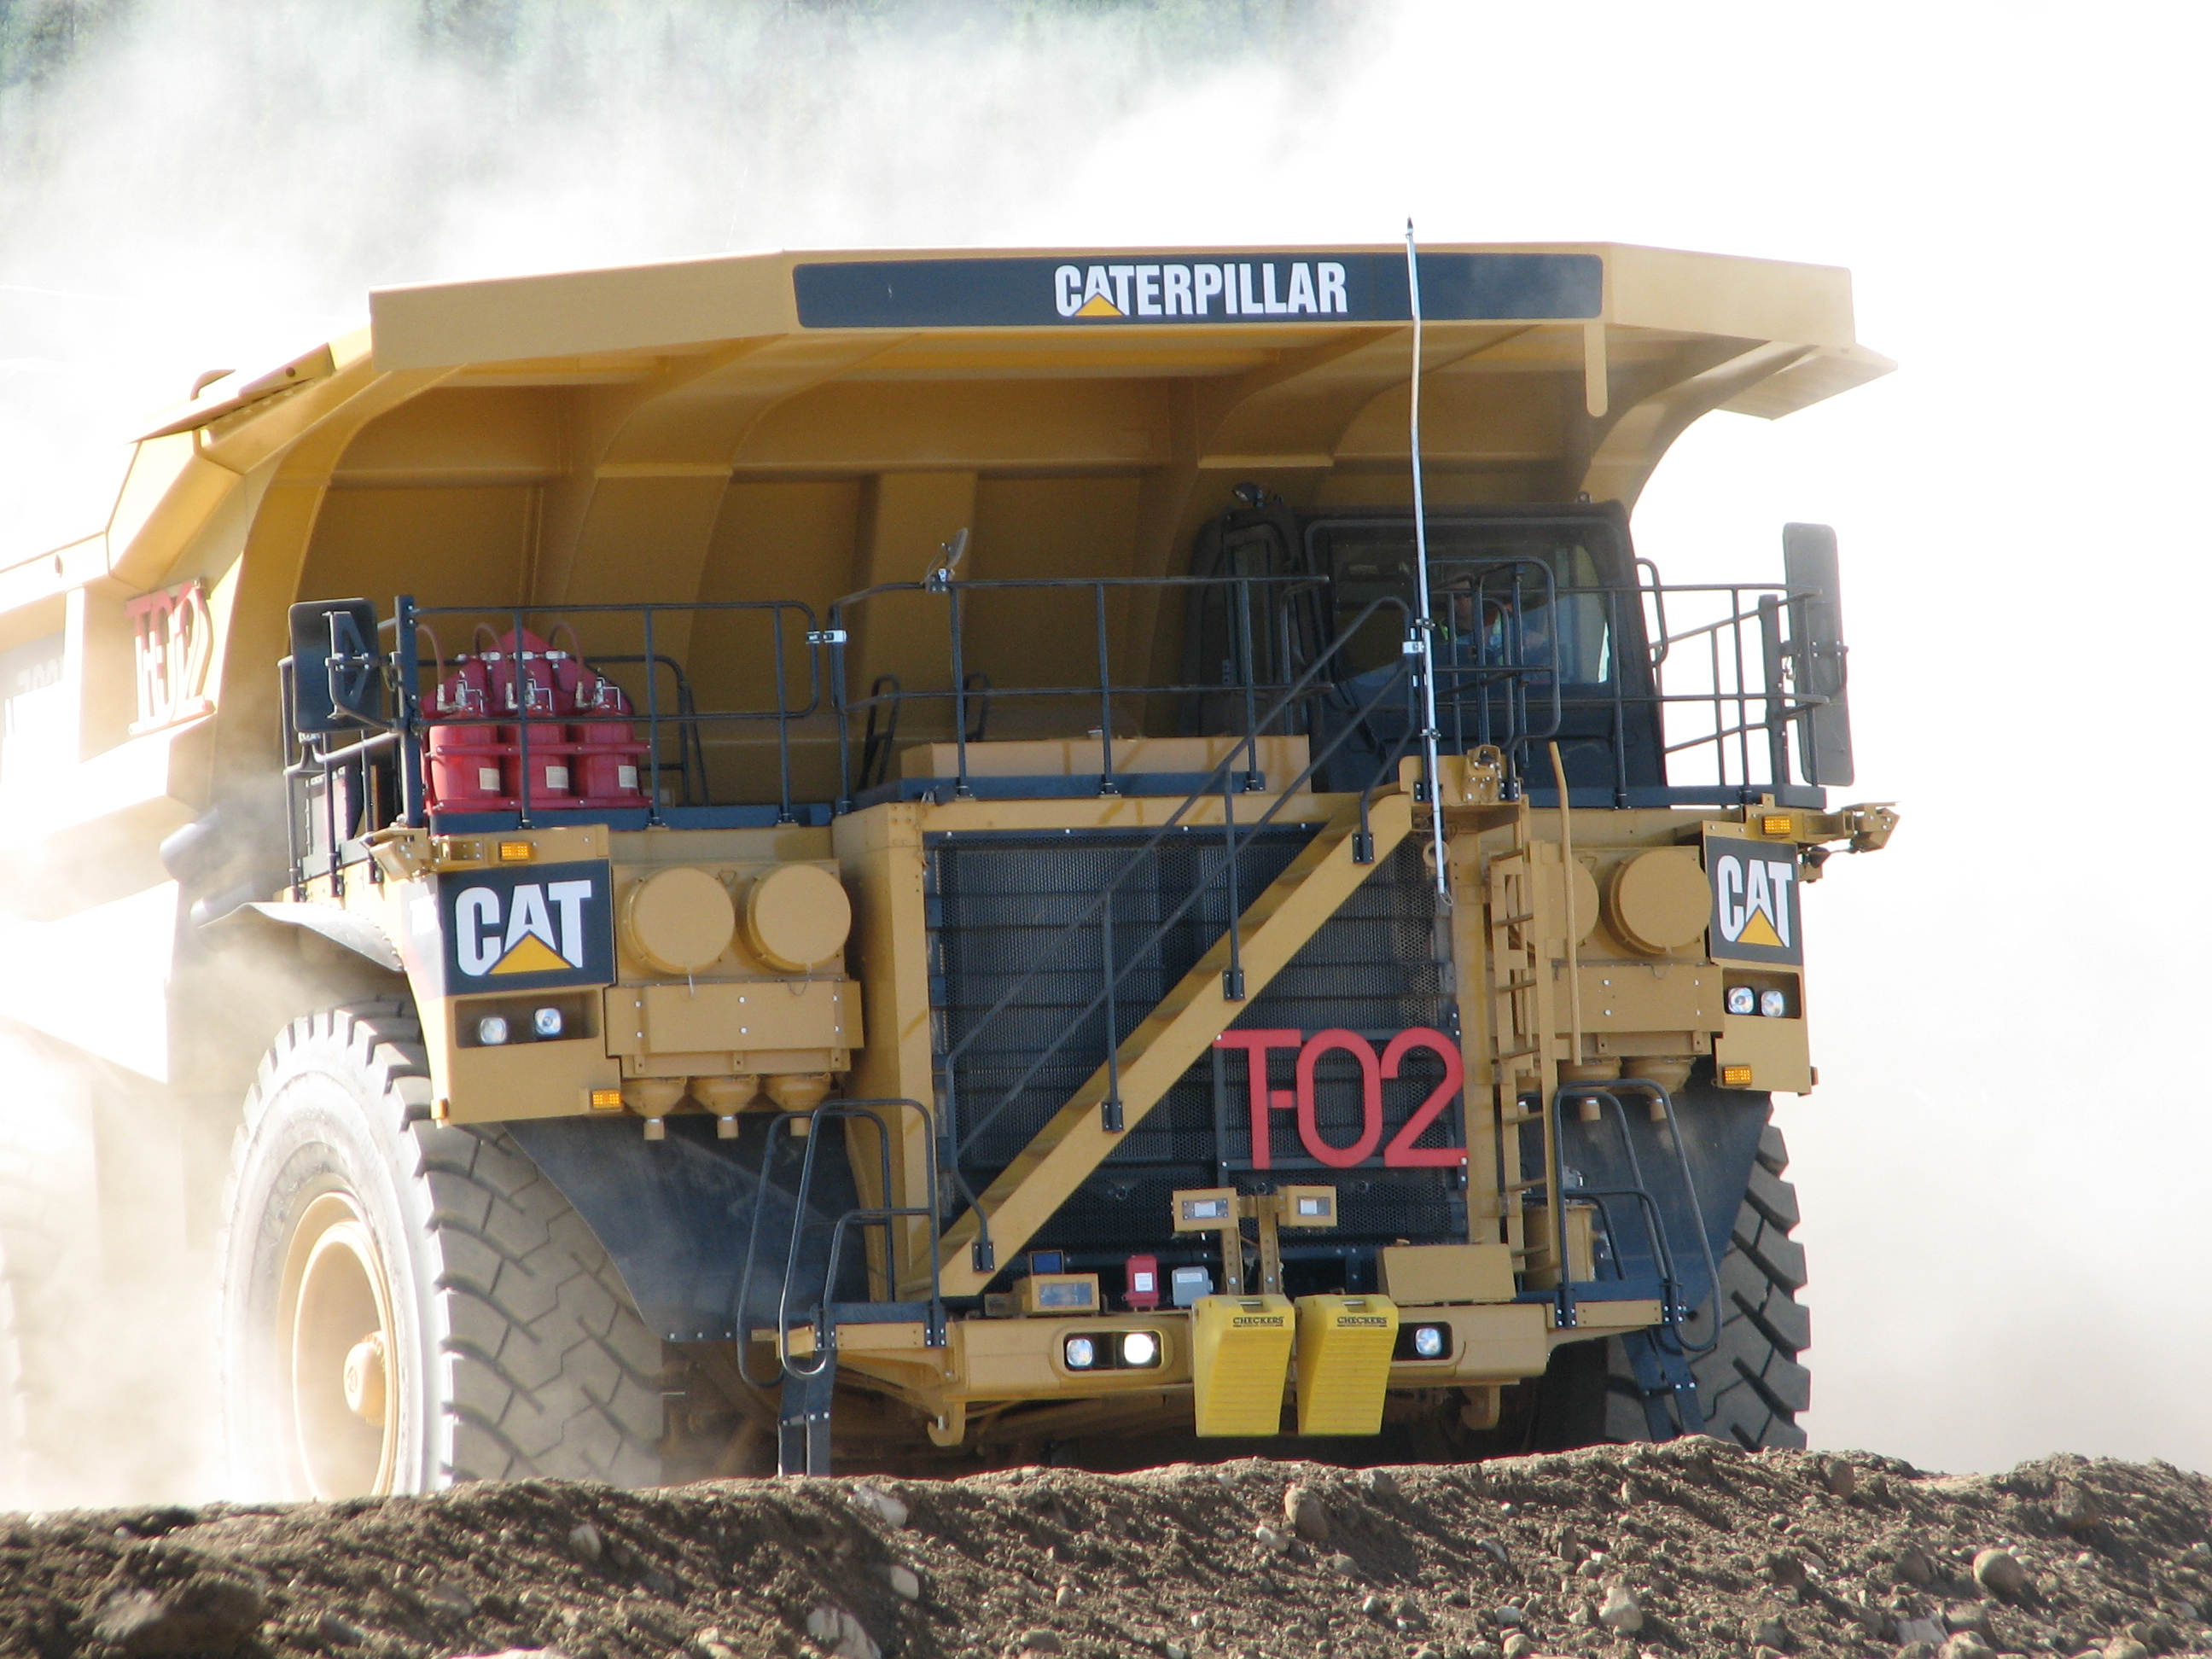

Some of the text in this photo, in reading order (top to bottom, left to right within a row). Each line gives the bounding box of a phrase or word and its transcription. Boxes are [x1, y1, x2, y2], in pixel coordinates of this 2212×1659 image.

[1055, 261, 1348, 317] CATERPILLAR
[455, 879, 592, 977] CAT
[1717, 855, 1793, 948] CAT
[1232, 1316, 1284, 1325] CHECKERS
[1336, 1316, 1388, 1325] CHECKERS
